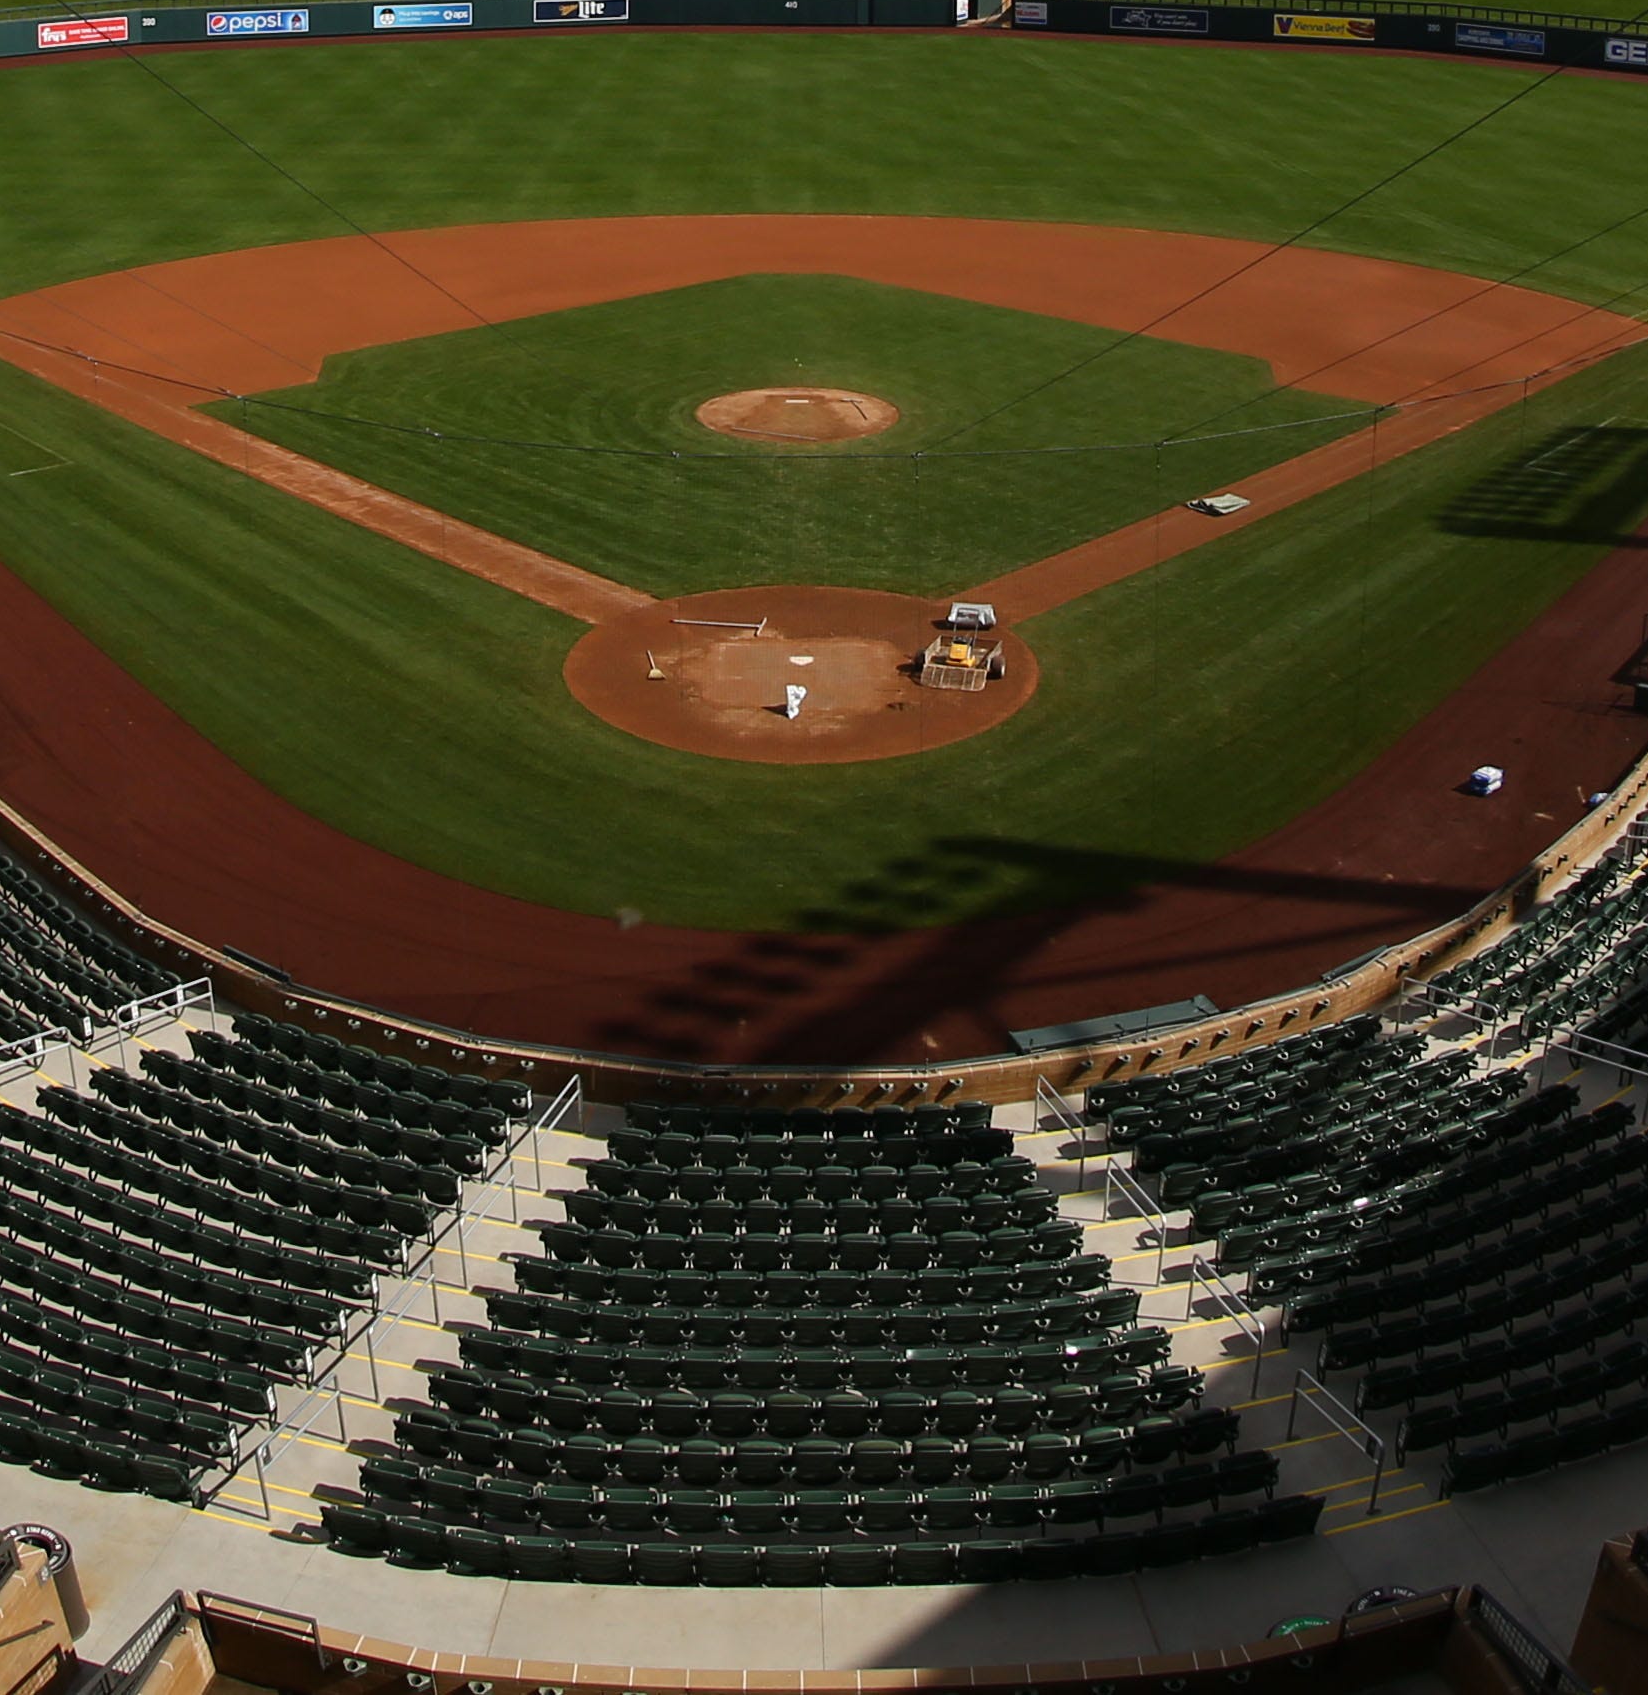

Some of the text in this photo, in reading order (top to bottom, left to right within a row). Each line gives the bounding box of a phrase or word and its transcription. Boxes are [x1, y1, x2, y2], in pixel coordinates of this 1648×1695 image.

[453, 11, 468, 19] aps
[578, 1, 605, 19] Lite
[230, 12, 282, 33] pepsi
[1294, 20, 1324, 32] Vienna
[1325, 21, 1346, 34] Beef
